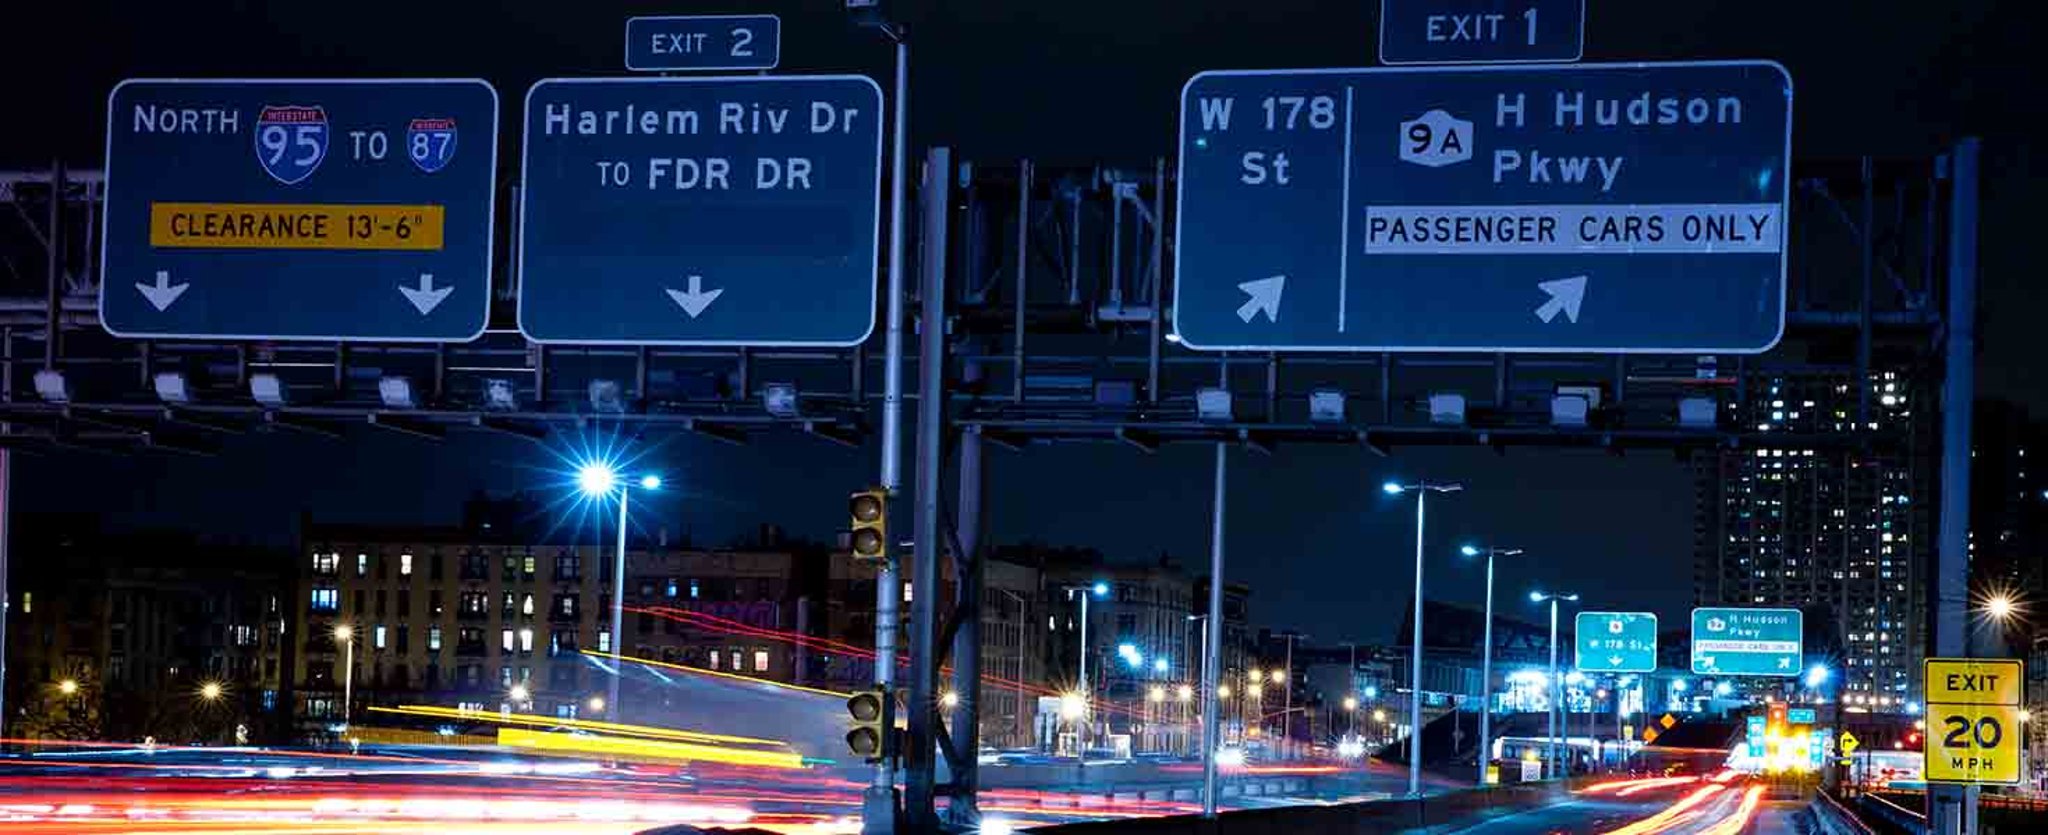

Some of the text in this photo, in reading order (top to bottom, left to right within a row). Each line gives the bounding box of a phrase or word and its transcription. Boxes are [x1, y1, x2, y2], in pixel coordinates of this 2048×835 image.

[652, 28, 753, 56] EXIT 2
[1427, 8, 1538, 45] EXIT 1
[133, 105, 239, 134] NORTH
[545, 101, 858, 135] Harlem Riv Dr
[1200, 96, 1335, 130] W 178
[1497, 91, 1742, 126] H Hudson
[263, 126, 321, 166] 95
[350, 131, 388, 160] TO
[412, 133, 451, 160] 87
[596, 157, 813, 190] TO FDR DR
[1241, 152, 1290, 185] St
[1493, 150, 1623, 192] Pkwy
[170, 213, 423, 239] CLEARANCE 13'-6"
[1369, 213, 1770, 244] PASSENGER CARS ONLY
[1947, 674, 1999, 691] EXIT
[1943, 715, 2003, 749] 20
[1951, 757, 1993, 769] MPH
